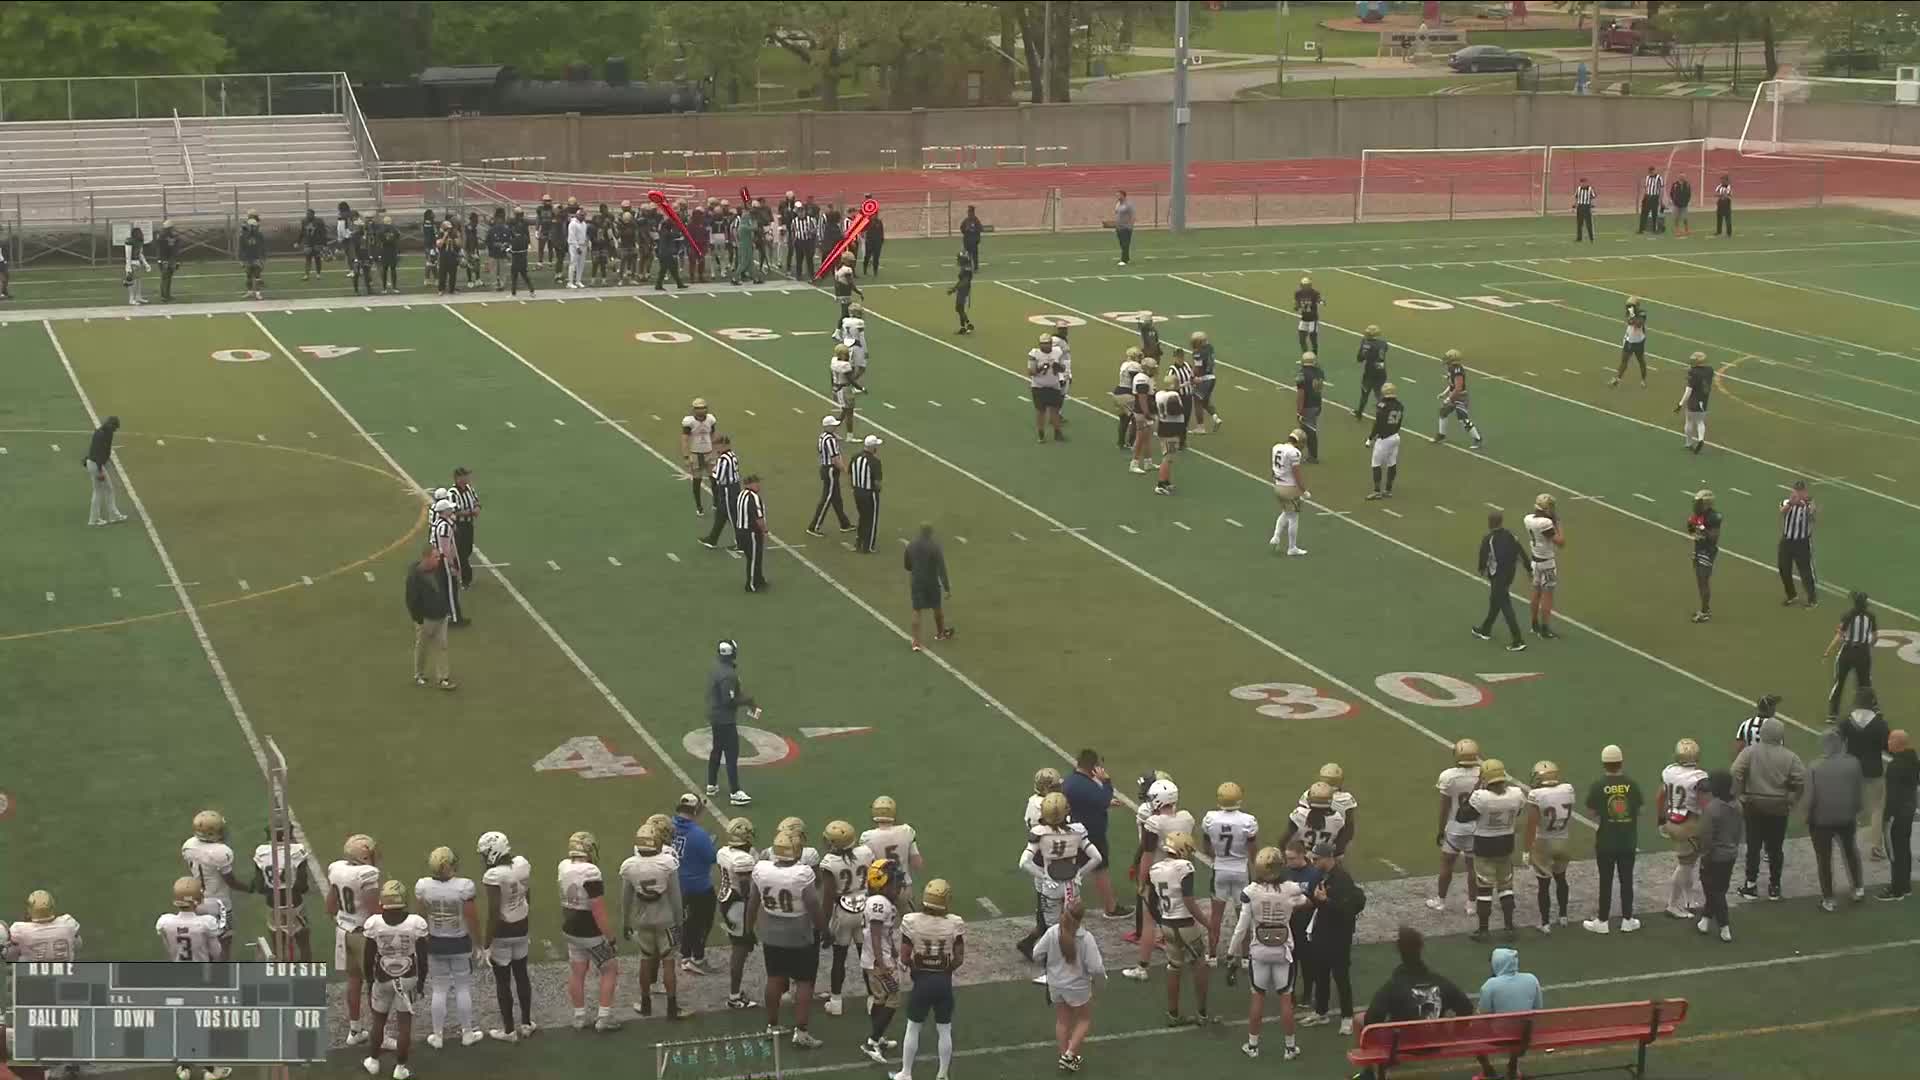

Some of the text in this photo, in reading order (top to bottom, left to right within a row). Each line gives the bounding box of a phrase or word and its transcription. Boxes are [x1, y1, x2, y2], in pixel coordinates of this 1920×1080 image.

[635, 328, 782, 343] 30
[211, 345, 361, 362] 40
[1229, 672, 1488, 719] 30
[533, 725, 797, 779] 40
[1603, 784, 1631, 795] OBEY
[1220, 834, 1233, 856] 7
[1158, 882, 1171, 912] 5
[872, 903, 884, 914] 22
